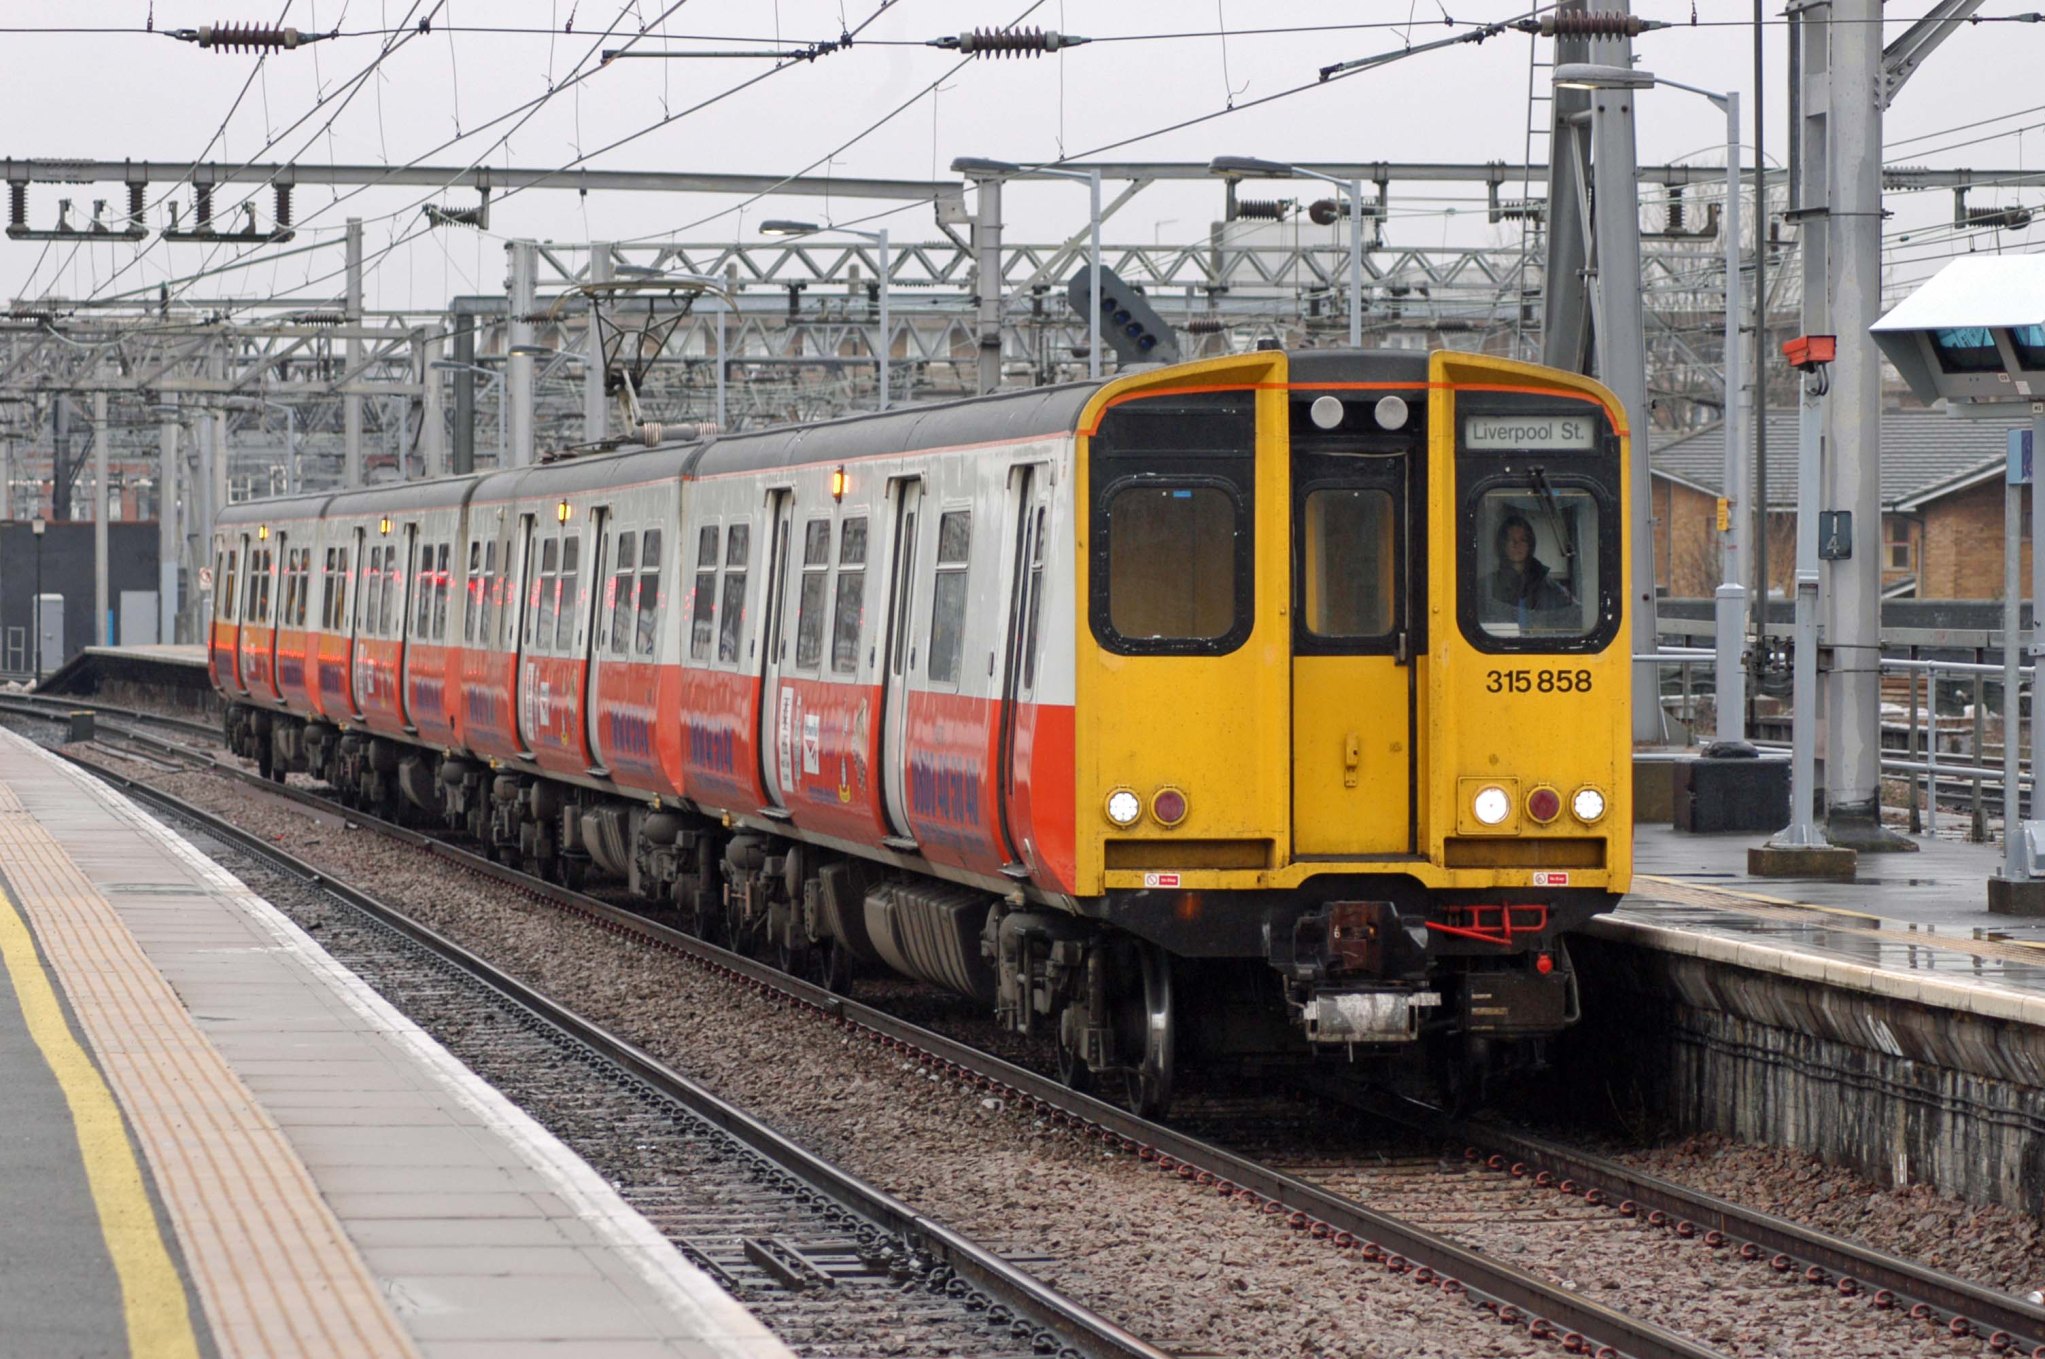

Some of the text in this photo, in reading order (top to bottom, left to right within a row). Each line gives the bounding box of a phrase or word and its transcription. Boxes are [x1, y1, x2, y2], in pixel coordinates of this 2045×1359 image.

[1473, 421, 1585, 443] Liverpool St.
[1486, 669, 1593, 693] 315 858
